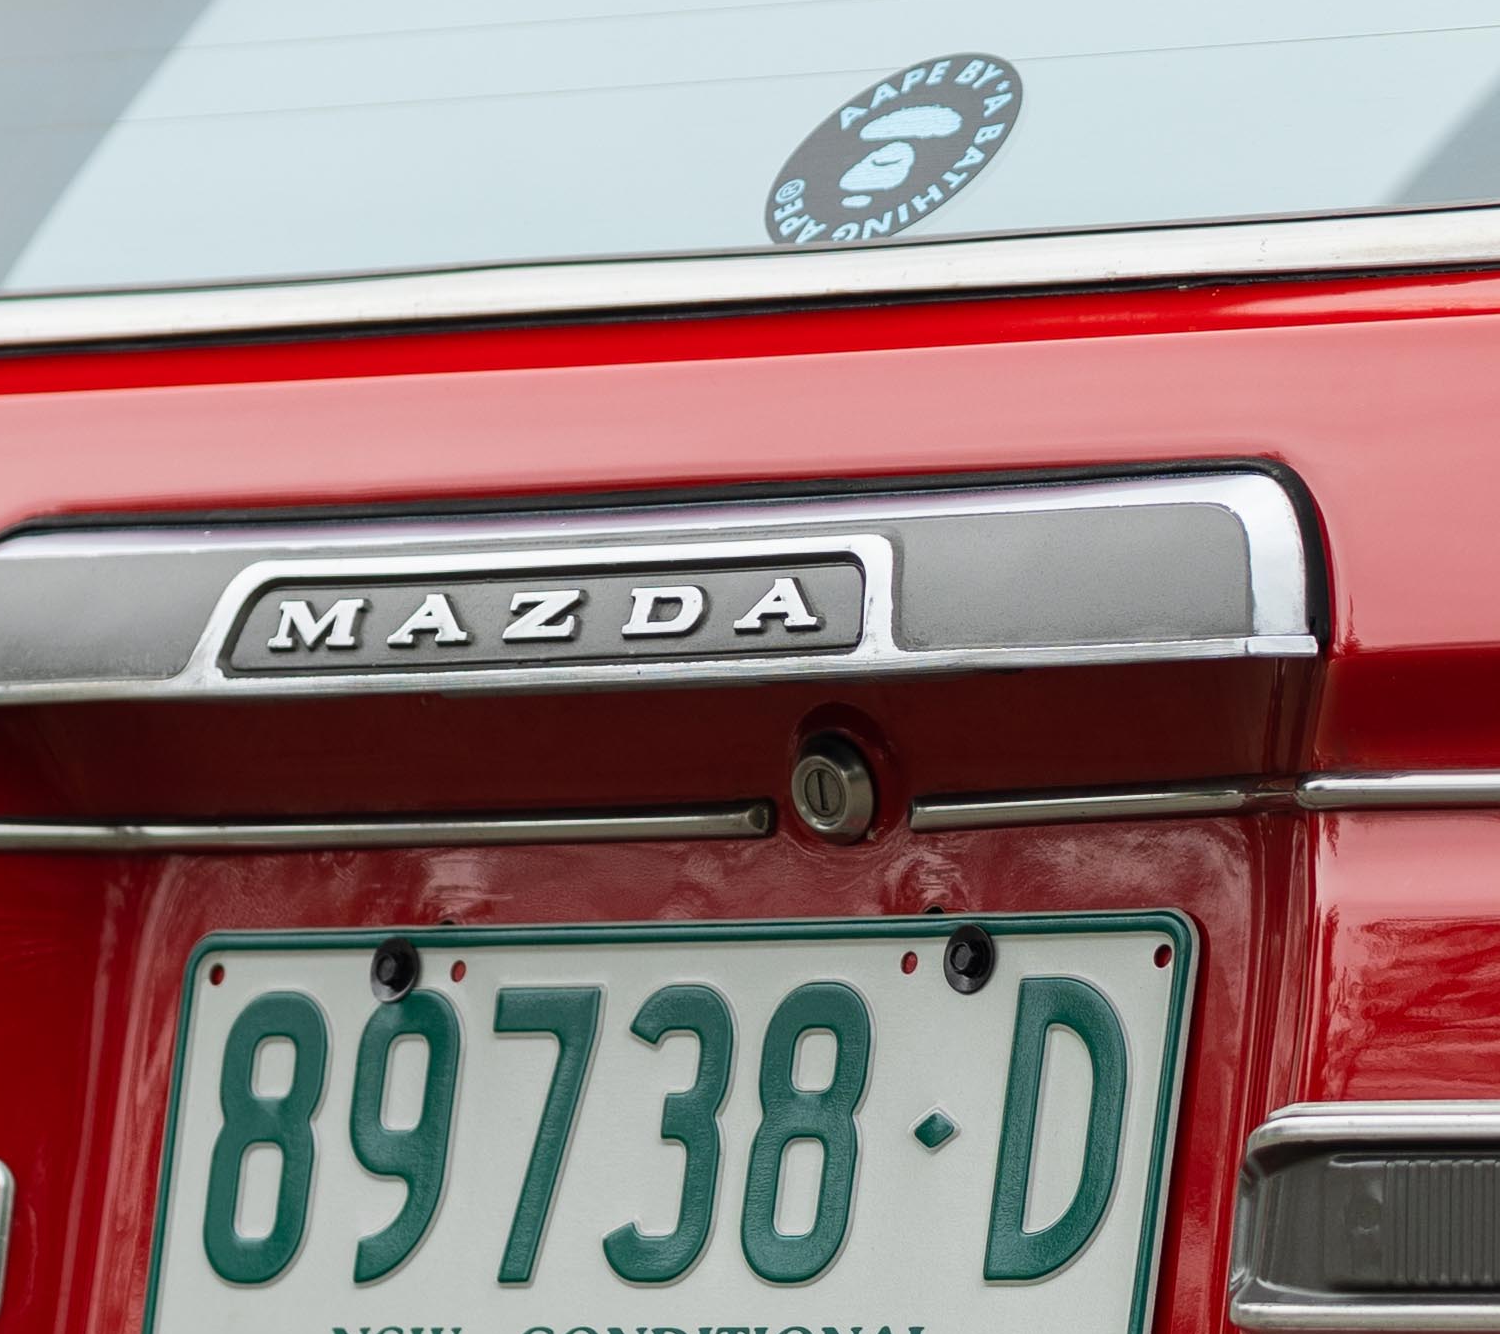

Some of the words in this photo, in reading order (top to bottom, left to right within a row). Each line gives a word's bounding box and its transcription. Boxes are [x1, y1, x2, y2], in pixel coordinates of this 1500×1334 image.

[840, 60, 952, 131] AAPE
[955, 58, 1004, 90] BY
[831, 122, 1005, 243] BATHING
[266, 576, 822, 651] MAZDA
